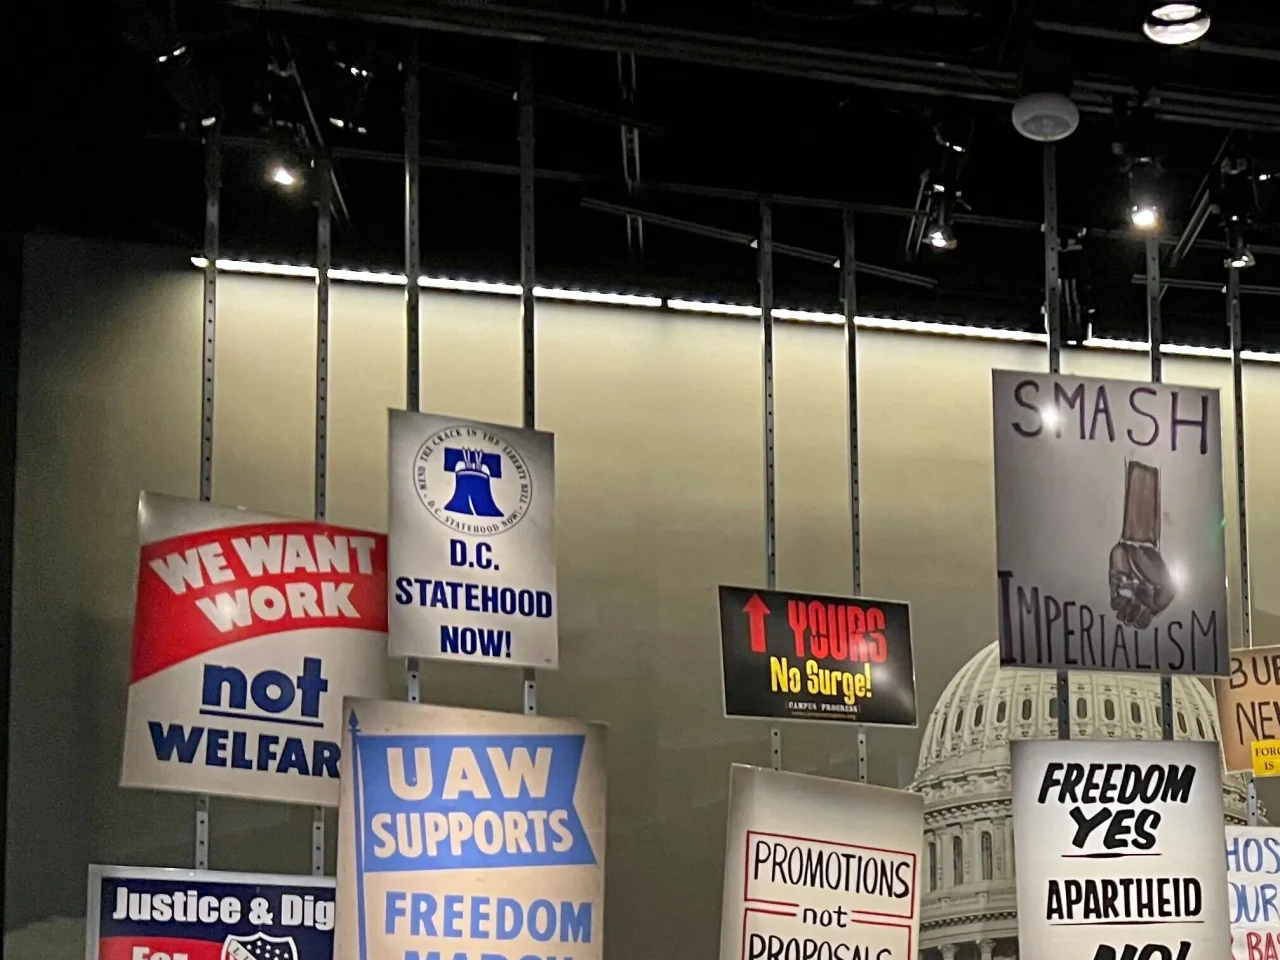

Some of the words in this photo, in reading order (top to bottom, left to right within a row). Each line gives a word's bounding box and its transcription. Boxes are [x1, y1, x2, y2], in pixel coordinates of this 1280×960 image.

[1012, 380, 1208, 455] SMASH
[149, 542, 235, 596] WE
[231, 534, 377, 578] WANT
[450, 538, 499, 570] D.C.
[195, 583, 361, 633] WORK
[395, 576, 553, 618] STATEHOOD
[997, 570, 1219, 672] IMPERIALISM
[440, 625, 511, 658] NOW!
[788, 600, 888, 663] YOURS
[202, 657, 328, 714] not
[770, 656, 801, 692] No
[806, 660, 872, 705] Surge!
[386, 747, 553, 800] UAW
[1038, 763, 1196, 805] FREEDOM
[1265, 762, 1274, 770] IS
[370, 809, 574, 858] SUPPORTS
[1069, 807, 1161, 850] YES
[754, 840, 910, 898] PROMOTIONS
[113, 886, 241, 926] Justice
[248, 897, 273, 927] &
[385, 891, 592, 943] FREEDOM
[803, 906, 848, 928] not
[1046, 877, 1202, 919] APARTHEID
